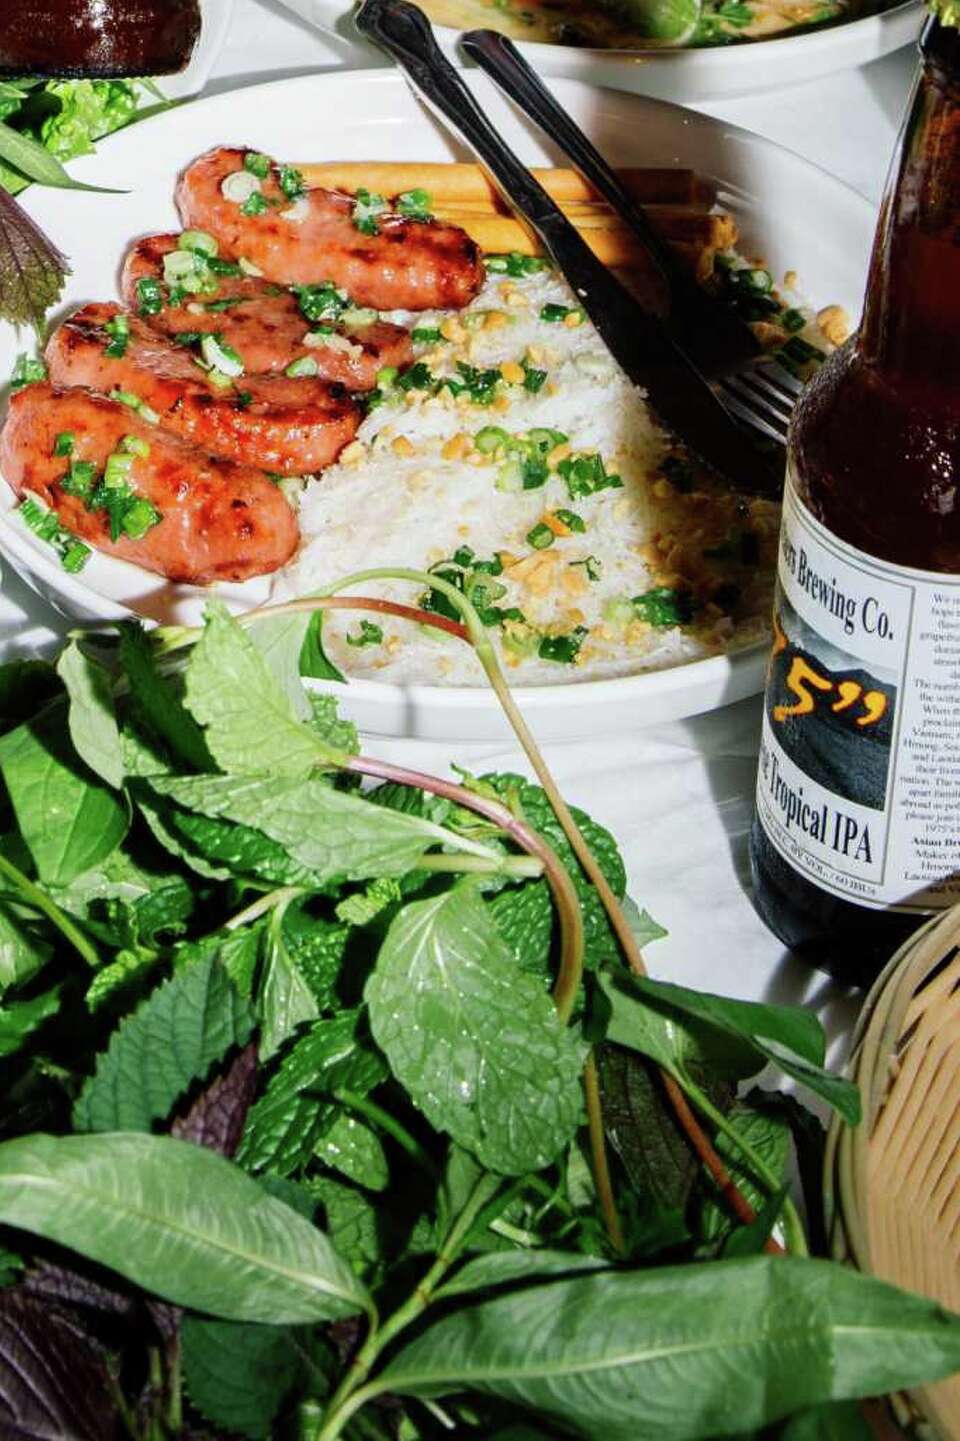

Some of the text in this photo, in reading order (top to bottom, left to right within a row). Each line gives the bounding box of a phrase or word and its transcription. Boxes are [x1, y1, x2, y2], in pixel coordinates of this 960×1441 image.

[796, 548, 857, 635] Brewing
[861, 596, 894, 641] Co.
[769, 751, 828, 845] Tropical
[832, 810, 872, 863] IPA
